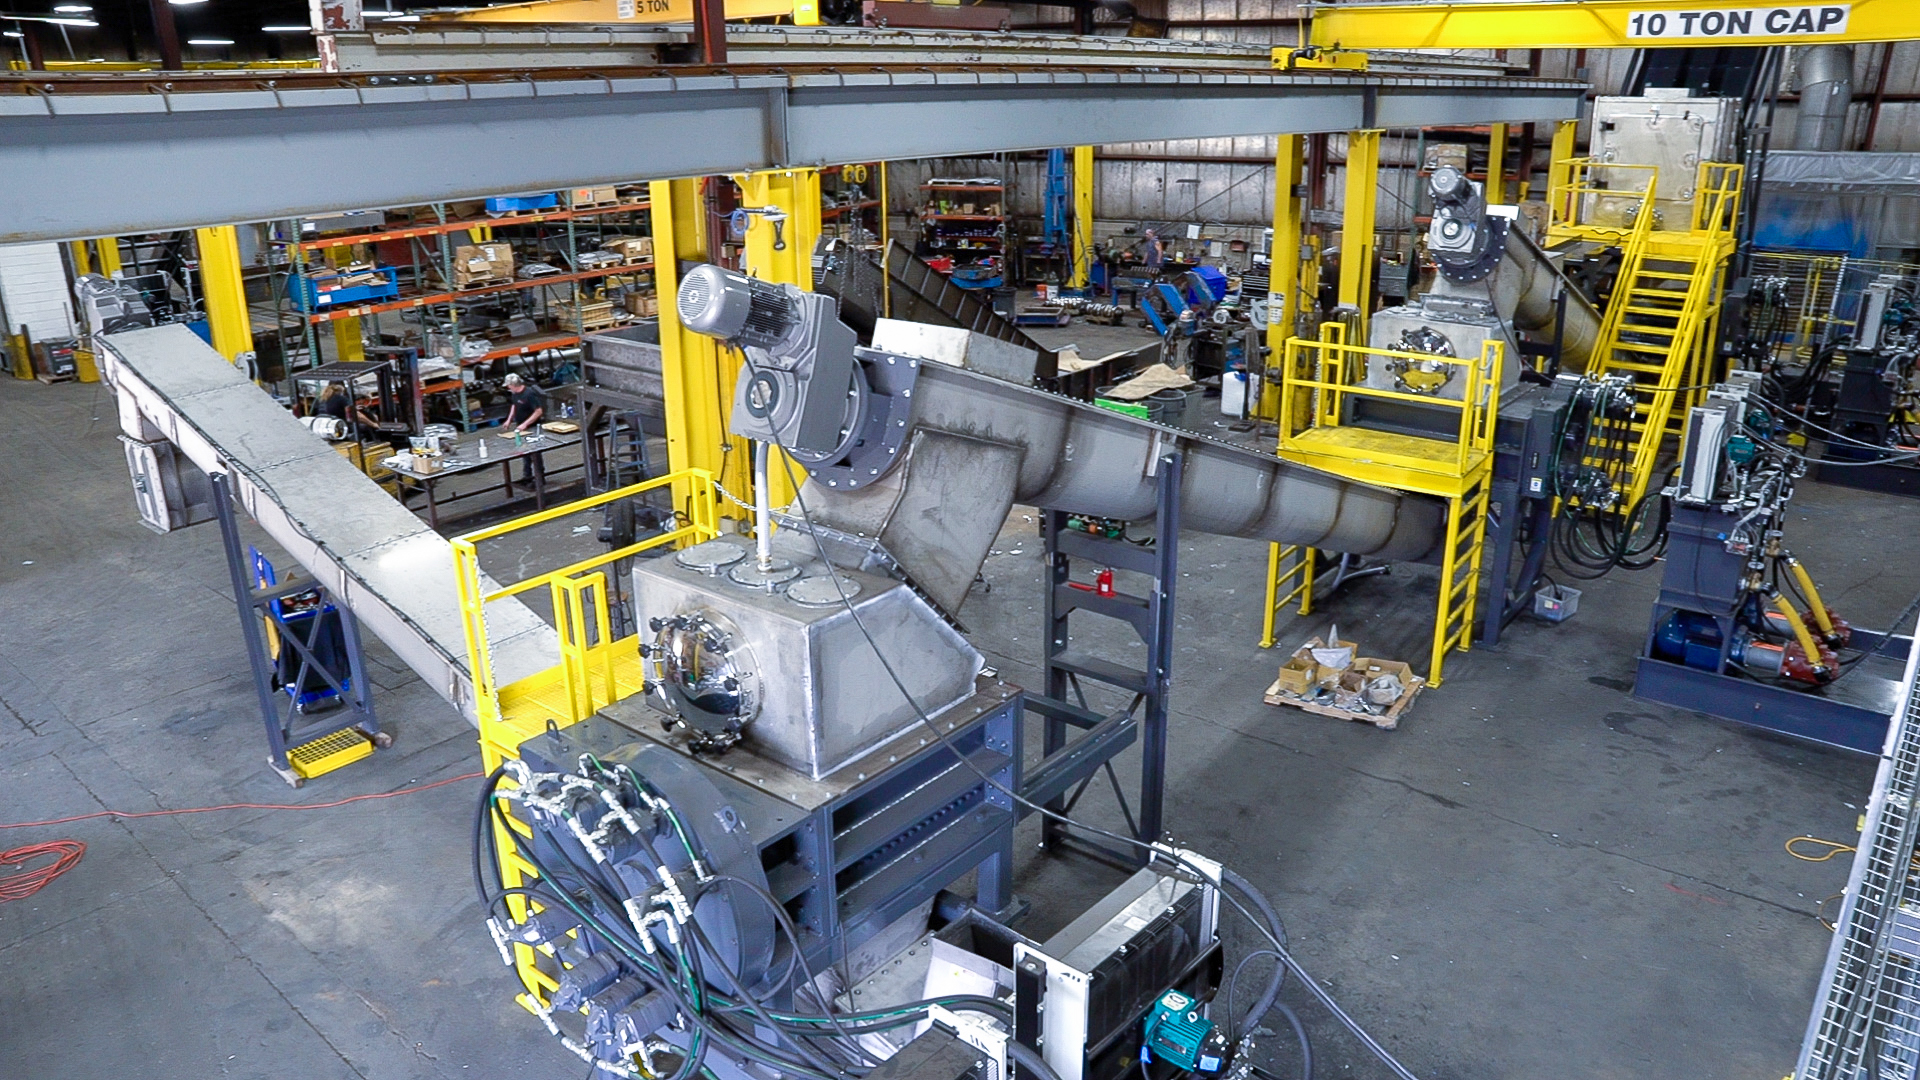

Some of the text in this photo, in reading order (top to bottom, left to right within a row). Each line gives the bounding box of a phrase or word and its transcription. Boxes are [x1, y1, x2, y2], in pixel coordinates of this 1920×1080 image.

[637, 0, 644, 14] 5
[647, 0, 669, 13] TON
[1632, 7, 1844, 36] 10 TON CAP
